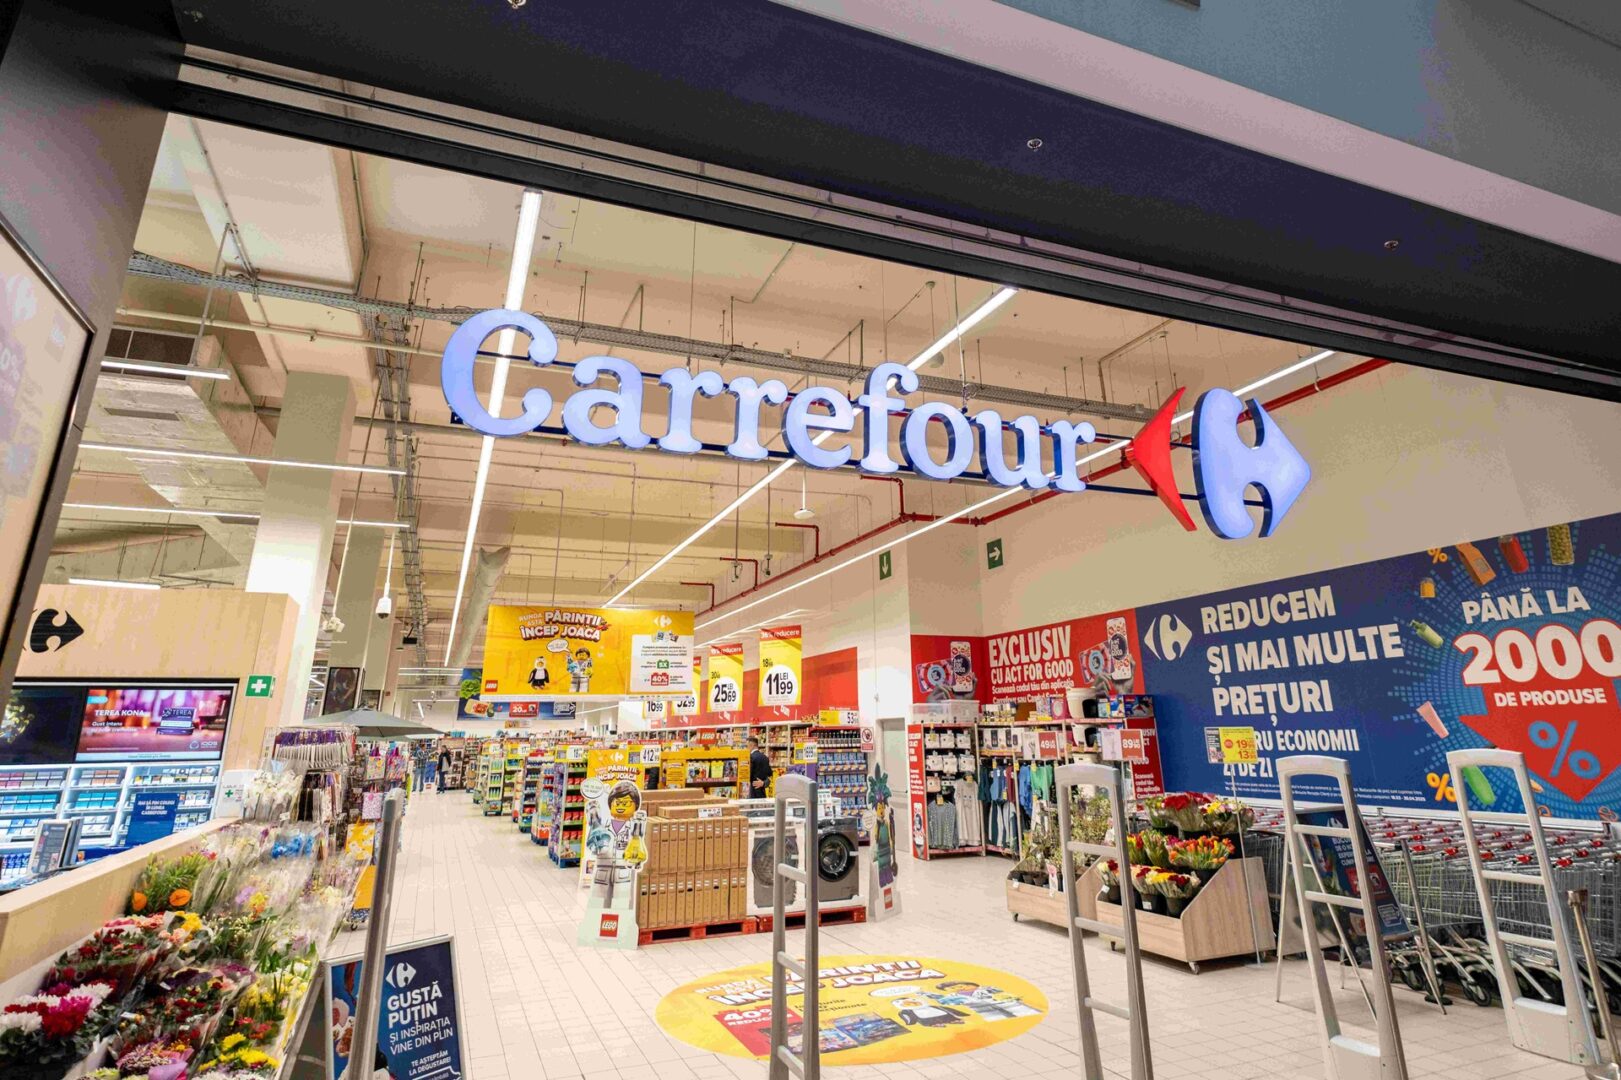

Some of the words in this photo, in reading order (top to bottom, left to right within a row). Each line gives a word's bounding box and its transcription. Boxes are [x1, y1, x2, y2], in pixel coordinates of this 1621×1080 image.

[440, 308, 1096, 493] Carrefour
[1200, 585, 1336, 634] REDUCEM
[1461, 587, 1543, 624] PÂNĂ
[1545, 586, 1591, 614] LA
[520, 625, 559, 639] ÎNCEP
[774, 629, 800, 637] reducere
[988, 625, 1071, 668] EXCLUSIV
[1206, 645, 1232, 686] ȘI
[1235, 638, 1290, 672] MAI
[1293, 623, 1405, 667] MULTE
[1454, 619, 1621, 685] 2000
[991, 667, 1003, 684] CU
[1005, 666, 1022, 683] ACT
[1023, 663, 1043, 681] FOR
[1044, 659, 1074, 679] GOOD
[714, 684, 727, 702] 25
[766, 673, 779, 695] 11
[780, 681, 793, 694] 99
[992, 683, 1016, 694] Scanează
[1212, 679, 1333, 726] PREȚURI
[1494, 692, 1518, 707] DE
[1519, 688, 1607, 706] PRODUSE
[1236, 739, 1247, 749] 19
[1275, 729, 1360, 752] ECONOMII
[1238, 750, 1249, 759] 13
[1260, 757, 1274, 778] ZI
[602, 921, 617, 929] LEGO
[832, 968, 946, 989] JOACA
[387, 980, 443, 1011] GUSTĂ
[388, 1000, 438, 1029] PUȚIN
[389, 1032, 399, 1046] ȘI
[400, 1016, 451, 1040] INSPIRAȚIA
[390, 1039, 414, 1055] VINE
[414, 1034, 433, 1048] DIN
[433, 1027, 453, 1043] PLIN
[409, 1068, 418, 1076] LA
